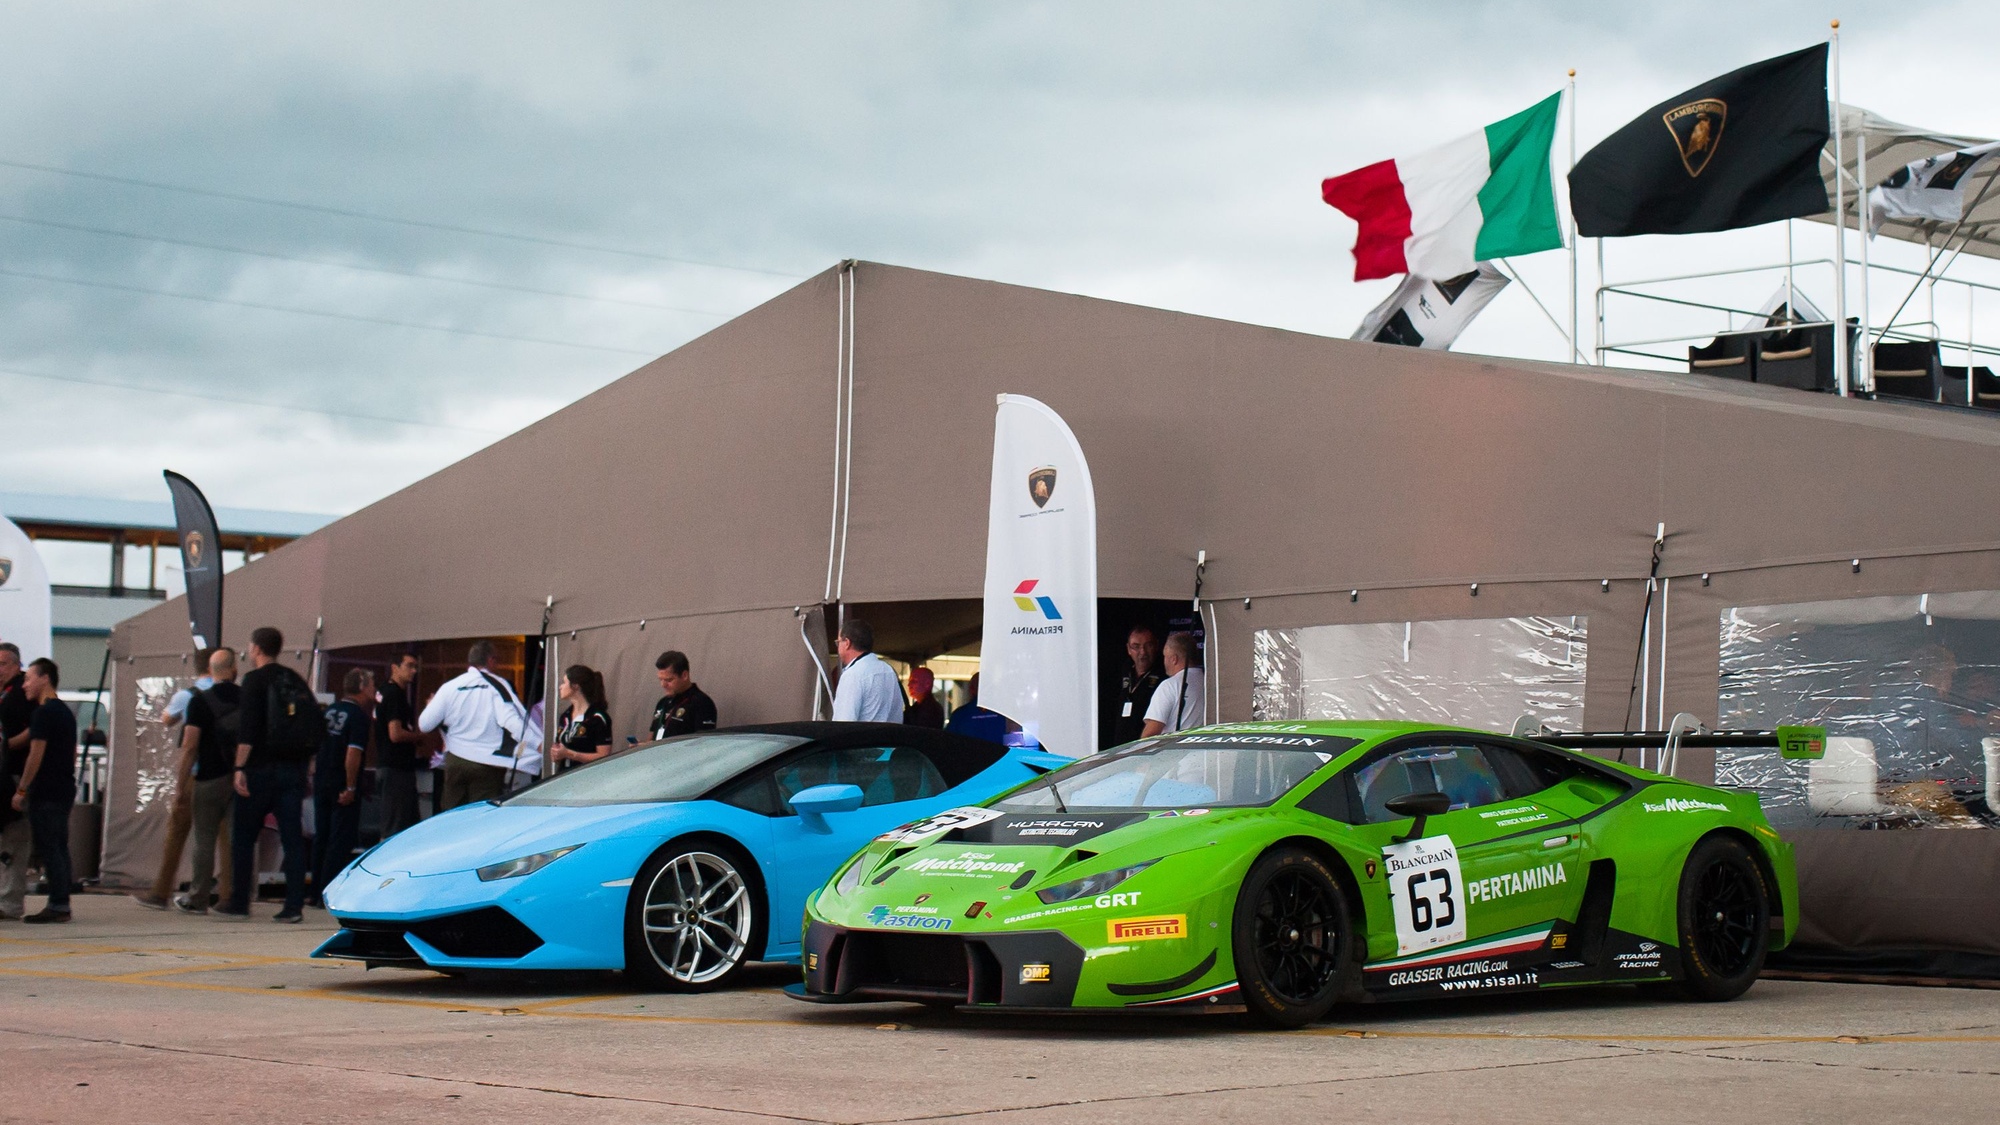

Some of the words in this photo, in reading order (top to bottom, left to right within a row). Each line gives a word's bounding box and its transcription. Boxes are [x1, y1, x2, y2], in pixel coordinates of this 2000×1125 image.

[1668, 103, 1723, 121] LAMBORG
[1176, 736, 1325, 747] BLANCPAIN
[1786, 740, 1822, 752] GT3
[1006, 820, 1104, 830] HURACAN
[903, 858, 1026, 873] Matchpoint
[1391, 848, 1454, 872] BLANCPAIN
[1468, 862, 1567, 905] PERTAMINA
[1095, 891, 1142, 908] GRT
[1407, 868, 1455, 932] 63
[894, 905, 939, 914] PERTAMINA
[1114, 919, 1179, 938] PIRELLI
[1552, 935, 1567, 946] OMP
[1022, 966, 1050, 979] OMP
[1388, 966, 1443, 986] GRASSER
[1440, 972, 1538, 991] www.sisal.it
